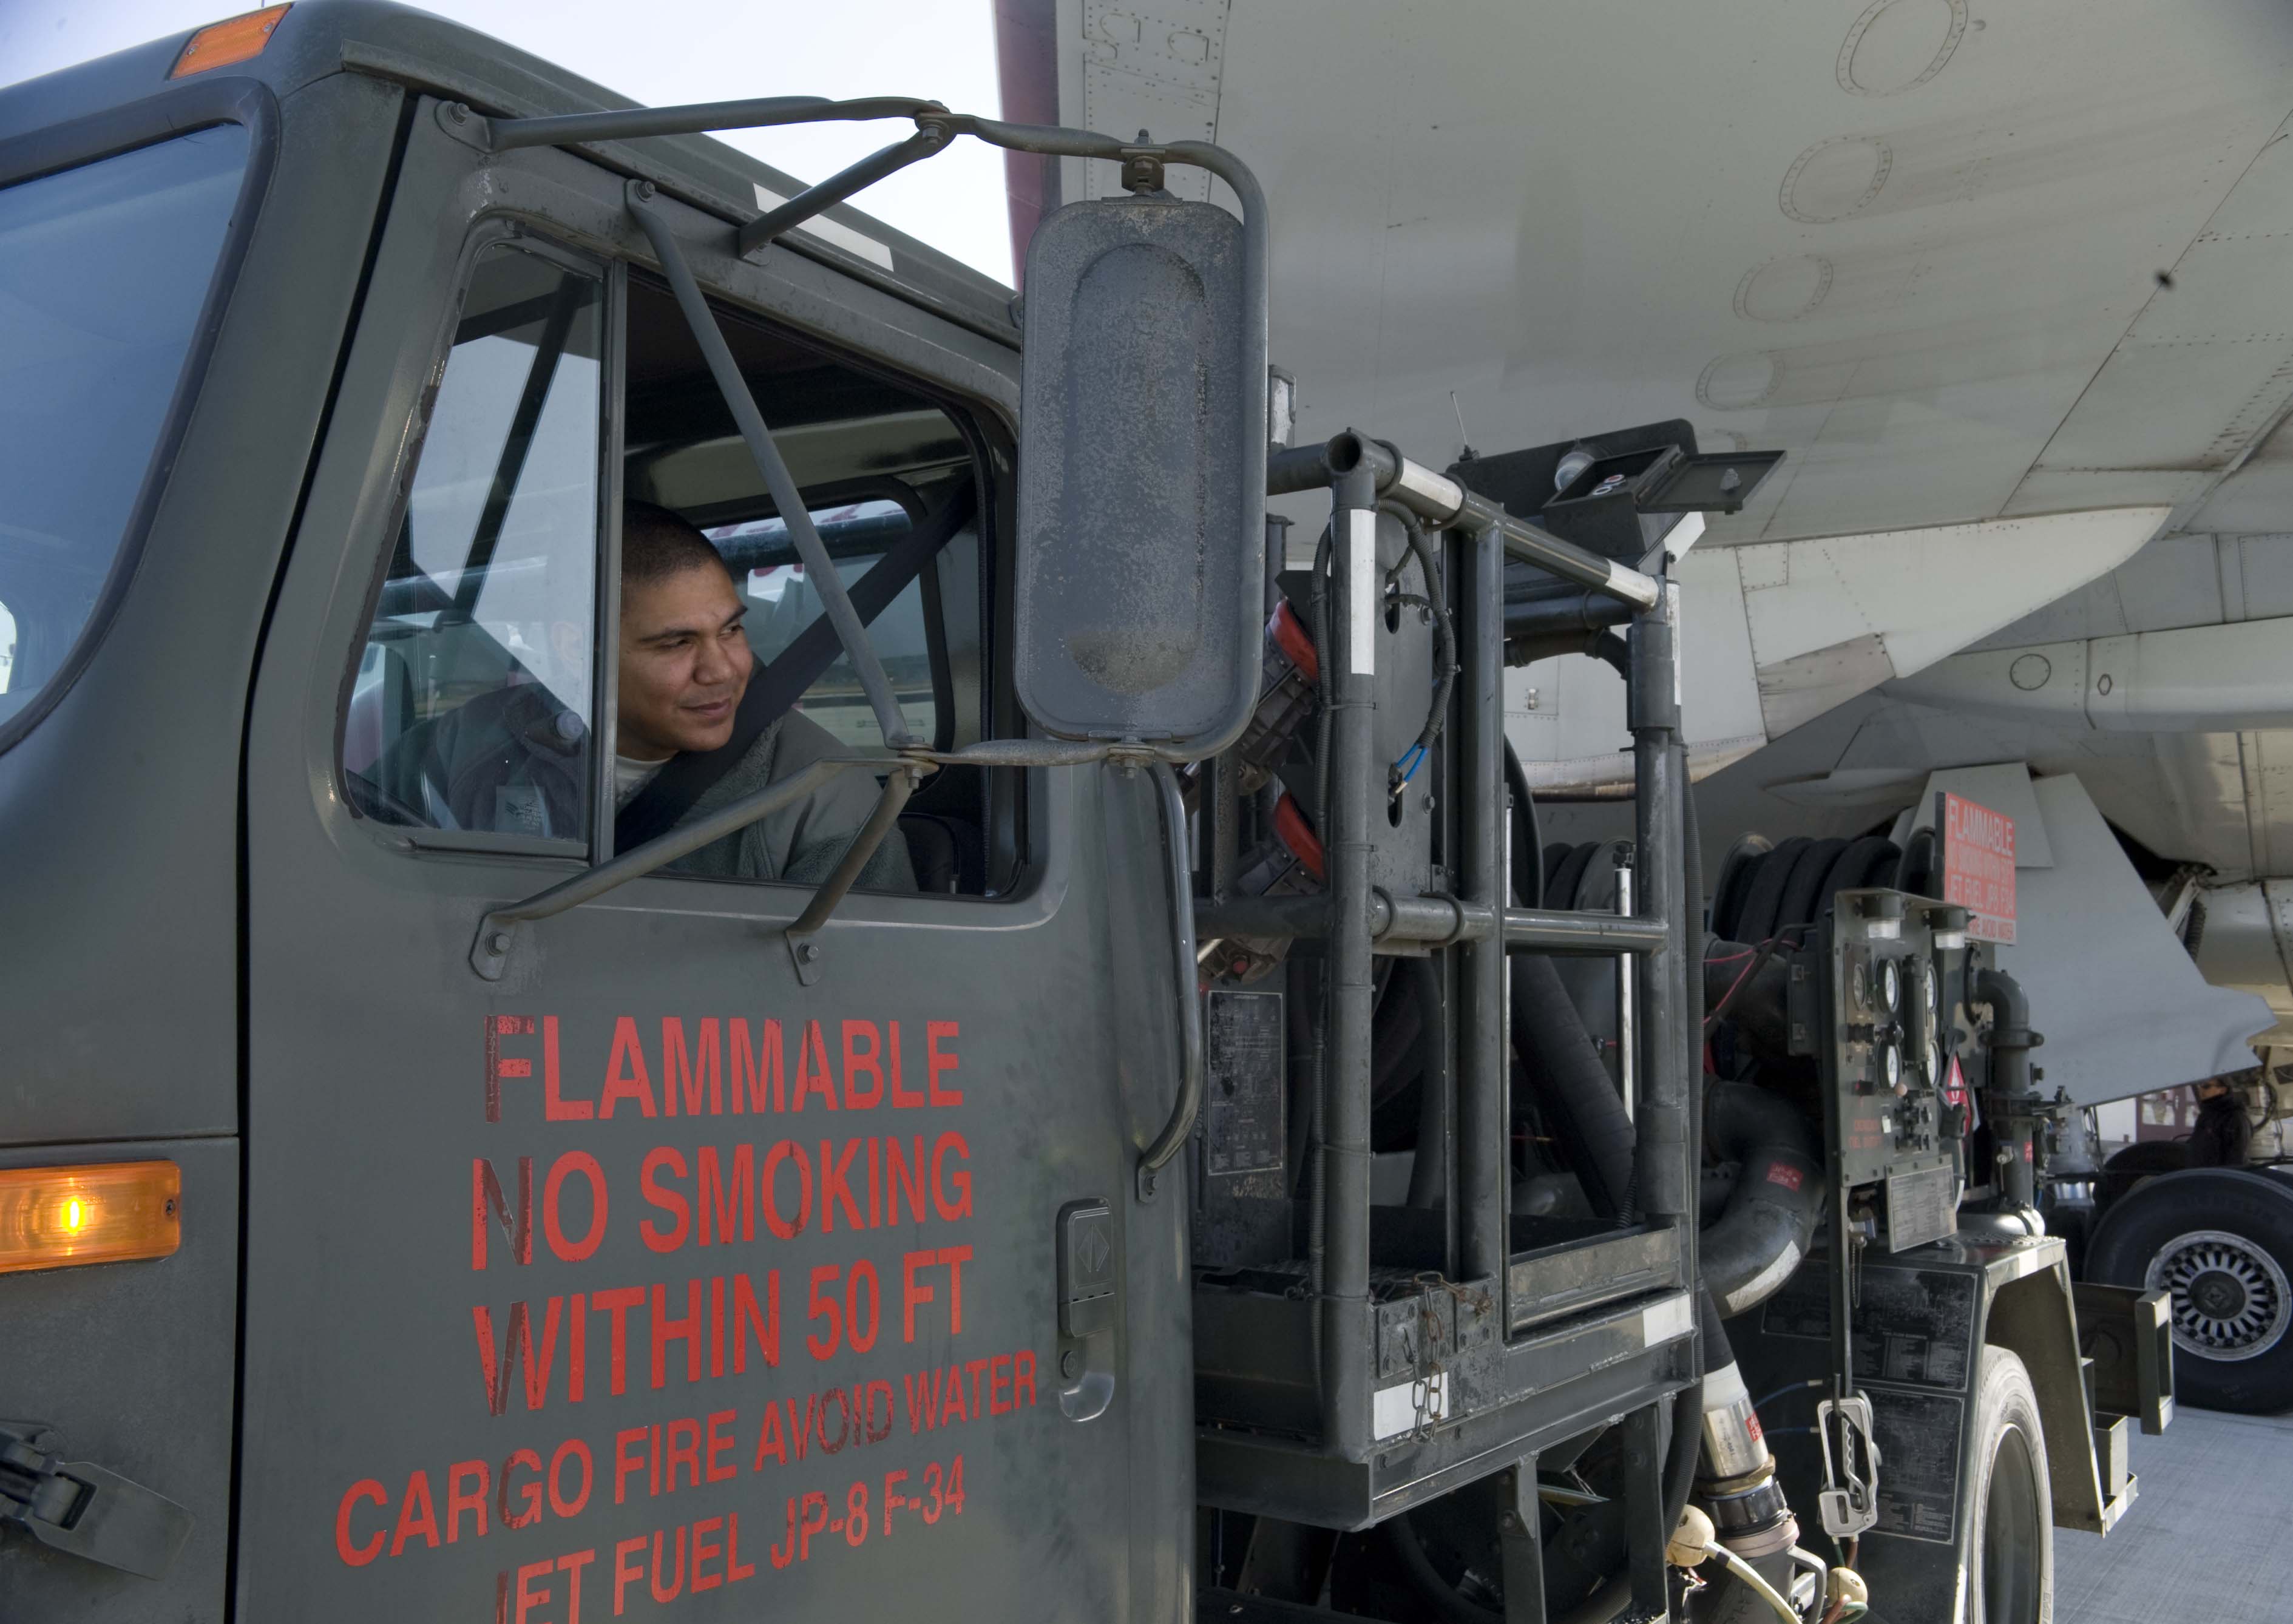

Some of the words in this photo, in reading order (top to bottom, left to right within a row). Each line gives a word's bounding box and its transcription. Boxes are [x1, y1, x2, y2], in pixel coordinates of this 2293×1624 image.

[1949, 797, 2013, 857] FLAMMABLE
[485, 1014, 964, 1123] FLAMMABLE
[472, 1149, 609, 1271] NO
[639, 1130, 974, 1254] SMOKING
[472, 1268, 781, 1416] WITHIN
[806, 1258, 880, 1362] 50
[903, 1244, 974, 1344] FT
[336, 1438, 594, 1567] CARGO
[615, 1408, 738, 1505] FIRE
[753, 1378, 895, 1473] AVOID
[903, 1349, 1037, 1435] WATER
[612, 1511, 756, 1617] FUEL
[770, 1481, 870, 1570] JP-8
[884, 1454, 967, 1537] F-34
